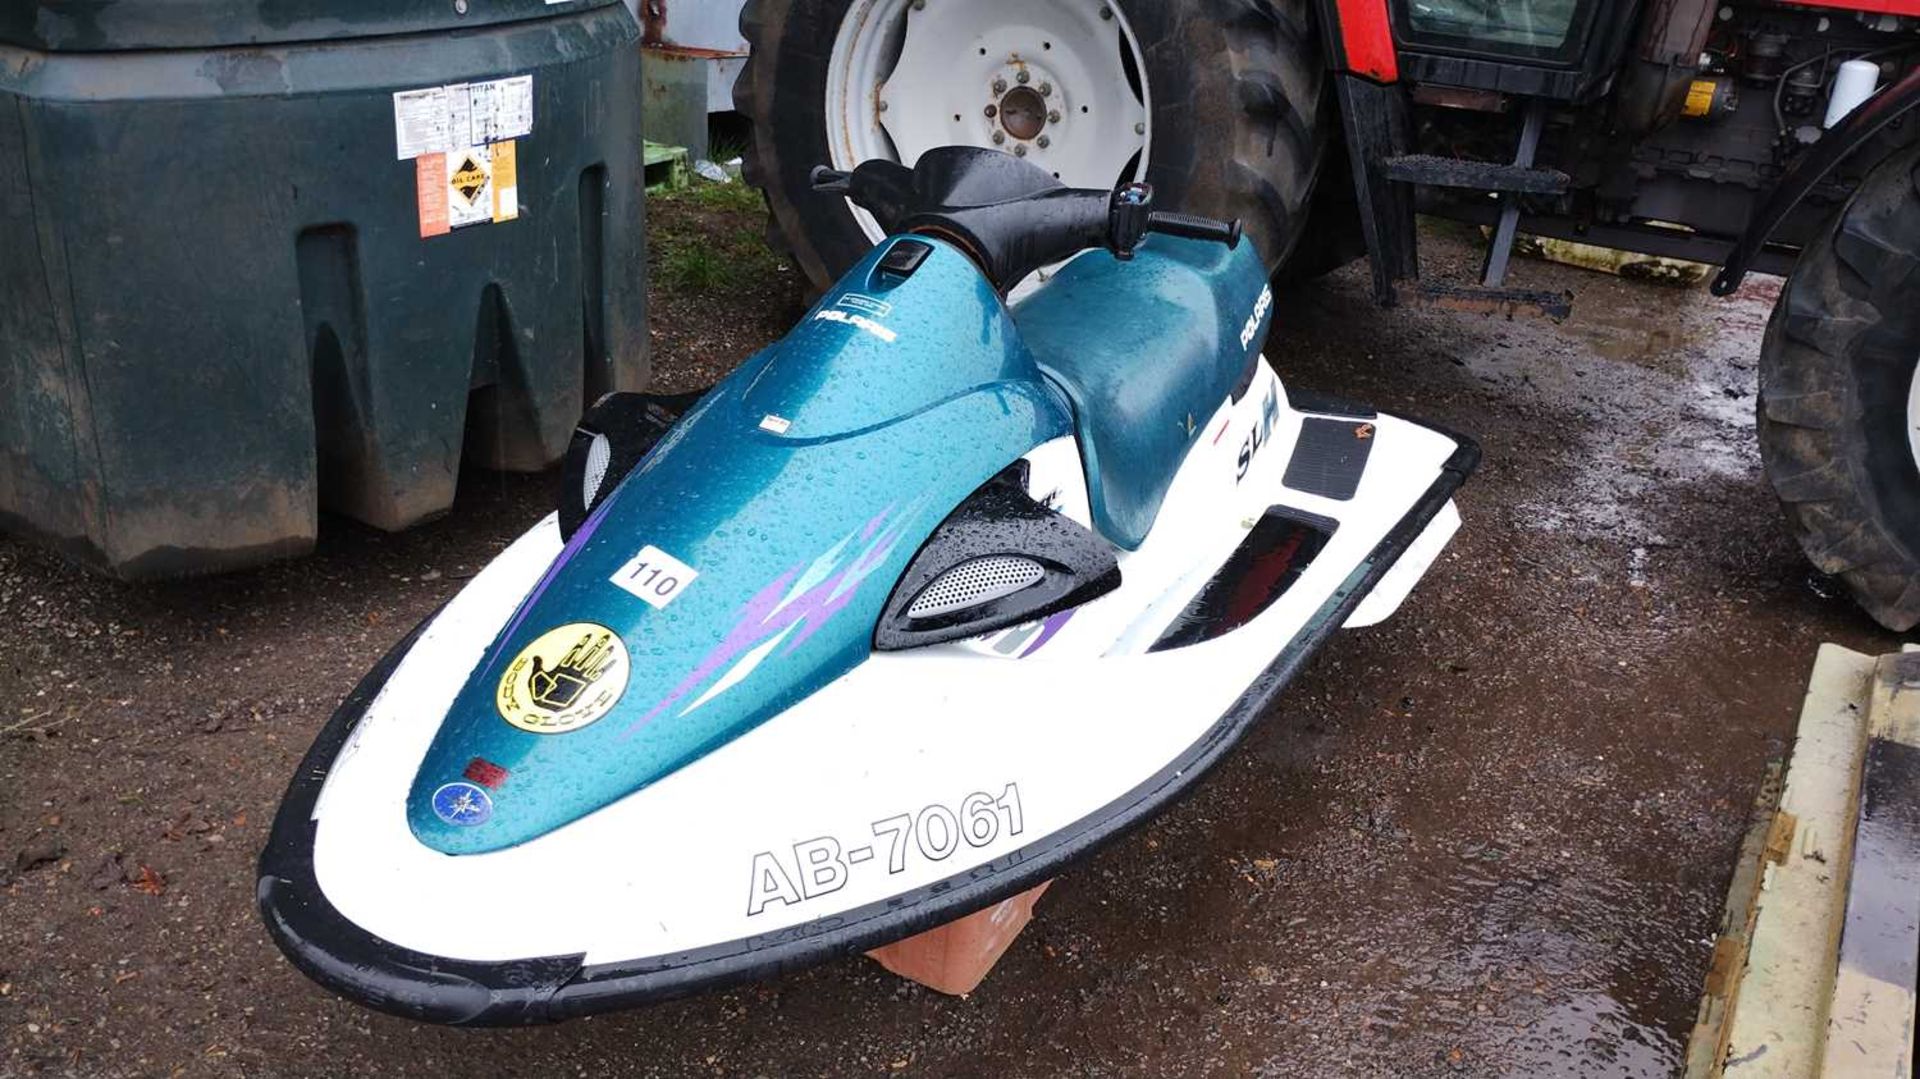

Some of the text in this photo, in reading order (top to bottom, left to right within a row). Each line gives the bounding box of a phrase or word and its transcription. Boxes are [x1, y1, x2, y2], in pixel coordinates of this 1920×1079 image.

[471, 83, 496, 93] TITAN
[815, 310, 897, 342] POLARIS
[1240, 284, 1272, 352] POLARIS
[1236, 374, 1280, 487] SLH
[630, 562, 678, 596] 110
[503, 657, 613, 727] BODY GLOVE
[747, 782, 1024, 917] AB-7061
